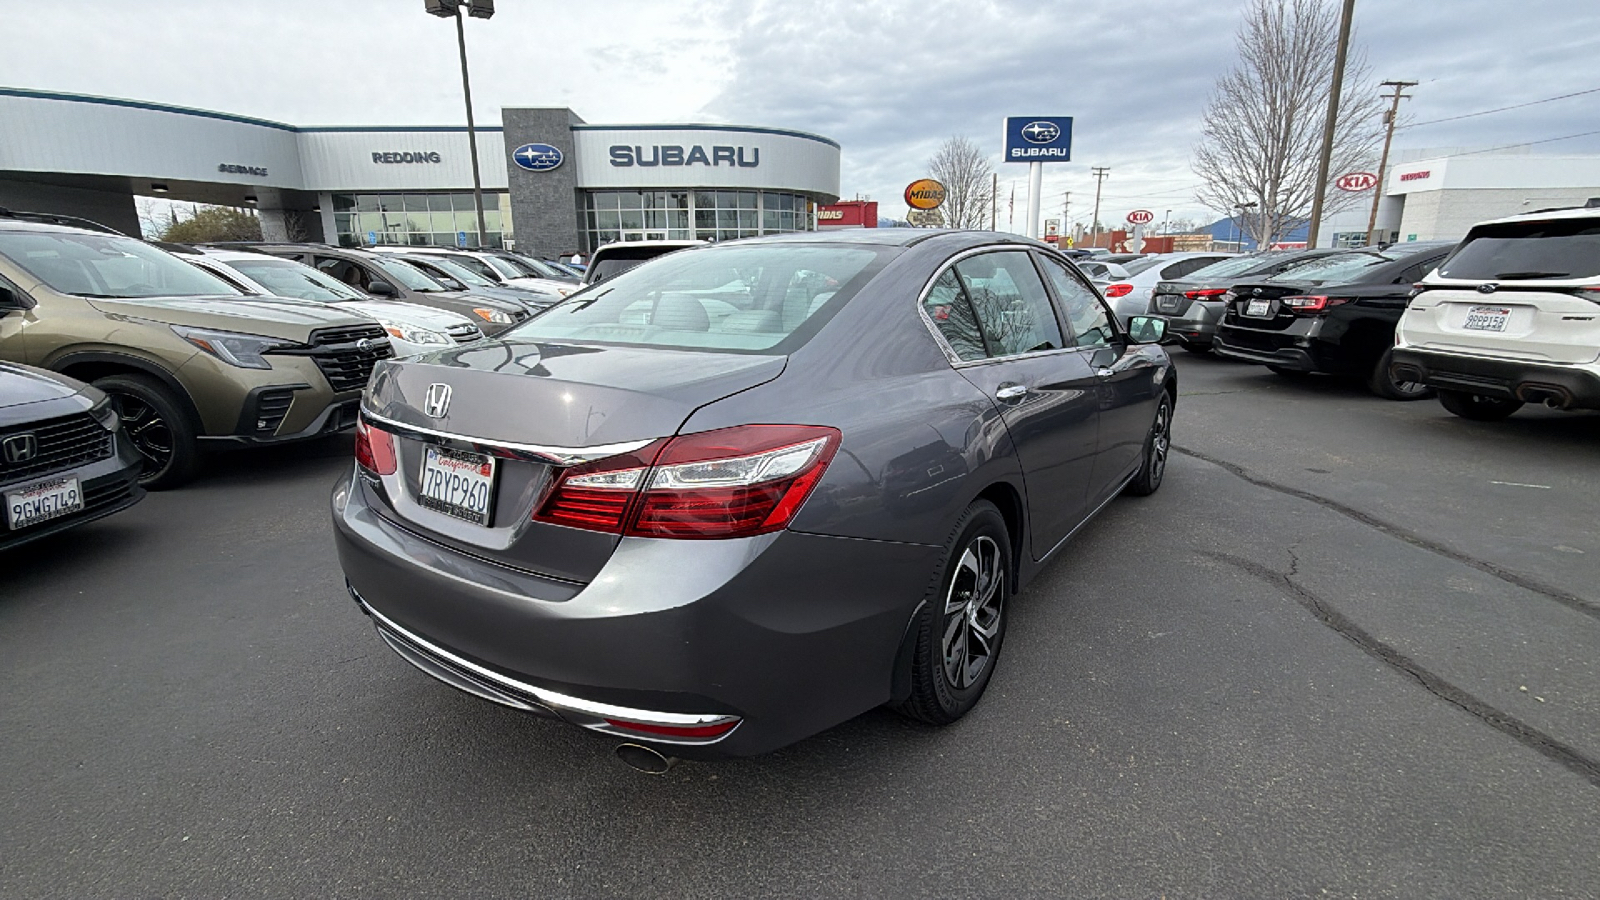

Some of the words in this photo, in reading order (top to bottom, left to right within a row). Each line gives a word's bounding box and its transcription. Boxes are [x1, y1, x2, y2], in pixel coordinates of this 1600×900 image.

[371, 151, 441, 164] REDDING
[609, 145, 760, 167] SUBARU
[1011, 147, 1067, 157] SUBARU
[1343, 176, 1371, 188] KIA
[1132, 212, 1150, 221] KIA
[427, 467, 488, 512] 7RYP960
[13, 489, 77, 523] 9GWG749
